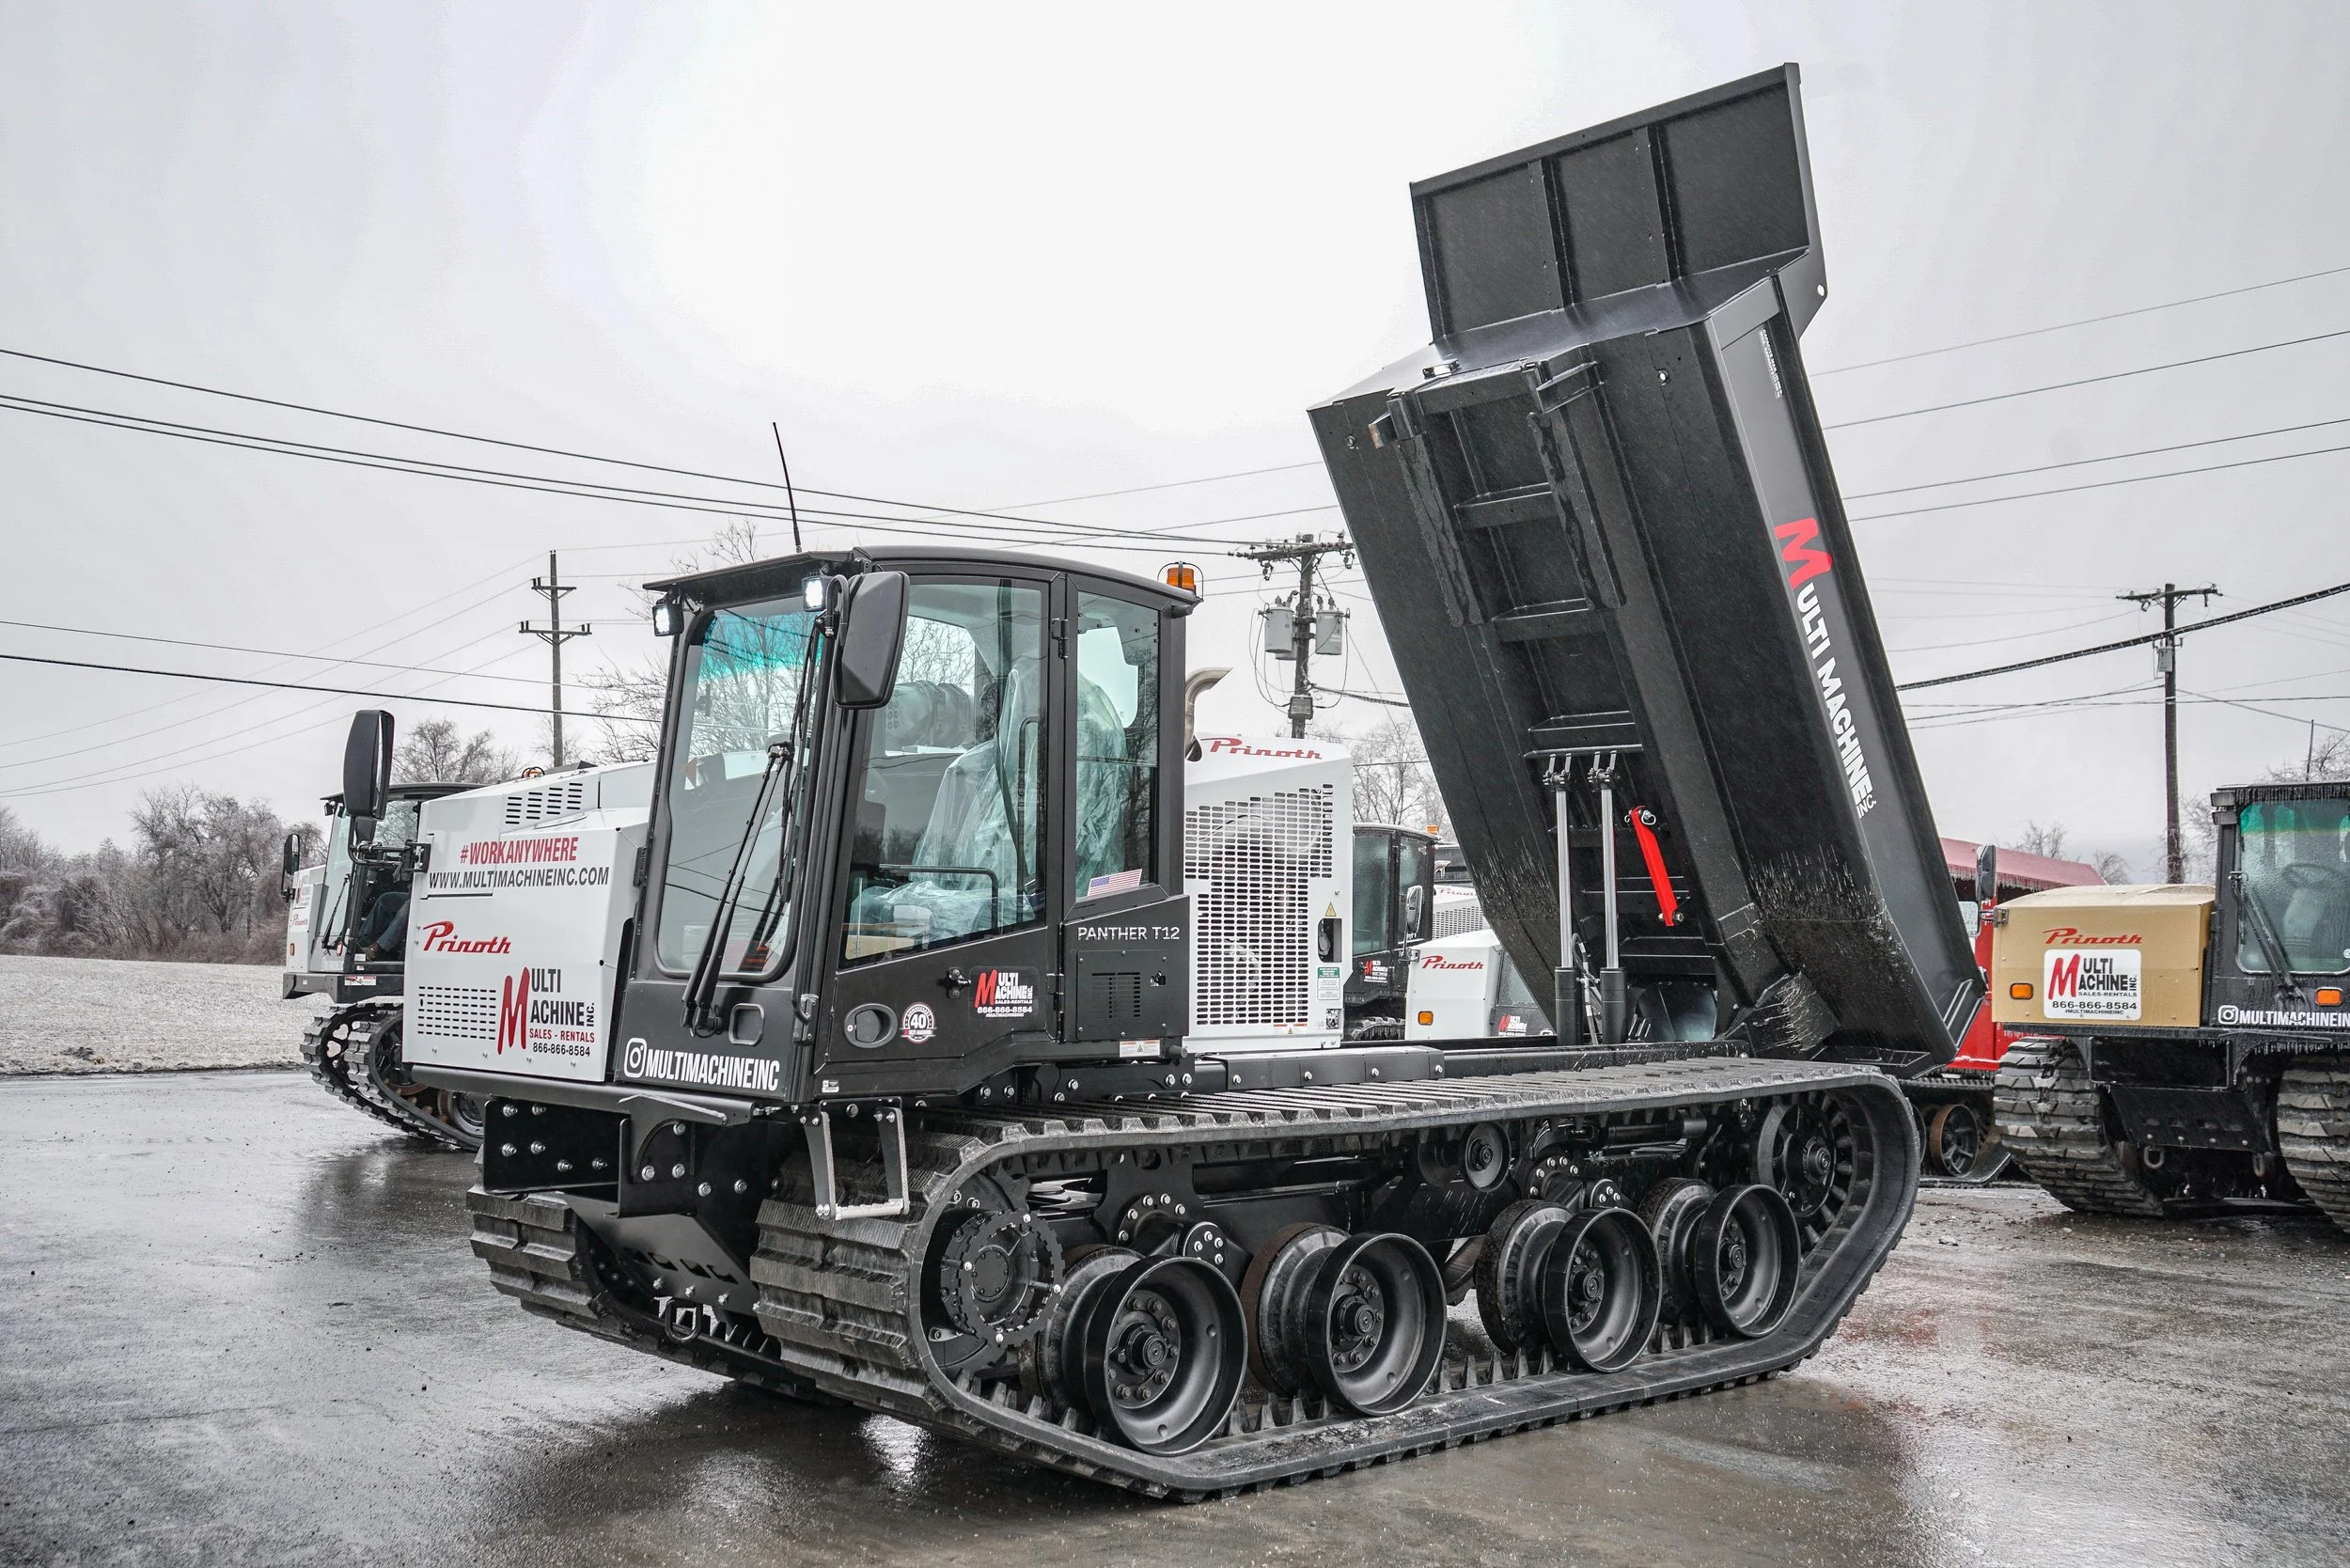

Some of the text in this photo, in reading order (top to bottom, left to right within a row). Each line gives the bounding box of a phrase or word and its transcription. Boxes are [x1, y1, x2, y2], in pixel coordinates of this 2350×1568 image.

[1774, 517, 1877, 820] MULTI MACHINE INC.
[1200, 737, 1323, 760] Prinoth
[460, 837, 579, 865] #WORKANYWHERE
[429, 867, 610, 889] WWW.MULTIMACHINEINC.COM
[423, 920, 511, 954] Prinoth
[1077, 926, 1181, 941] PANTHER T12
[2043, 928, 2142, 945] Prinoth
[1420, 955, 1484, 970] Prinoth
[977, 1006, 1033, 1014] 866-866-8584
[2052, 1001, 2138, 1010] 866-866-8584
[910, 1013, 927, 1029] 40
[529, 1027, 552, 1040] SALES
[560, 1030, 595, 1043] RENTALS
[532, 1042, 590, 1057] 866-866-8584
[645, 1048, 780, 1091] MULTIMACHINEINC
